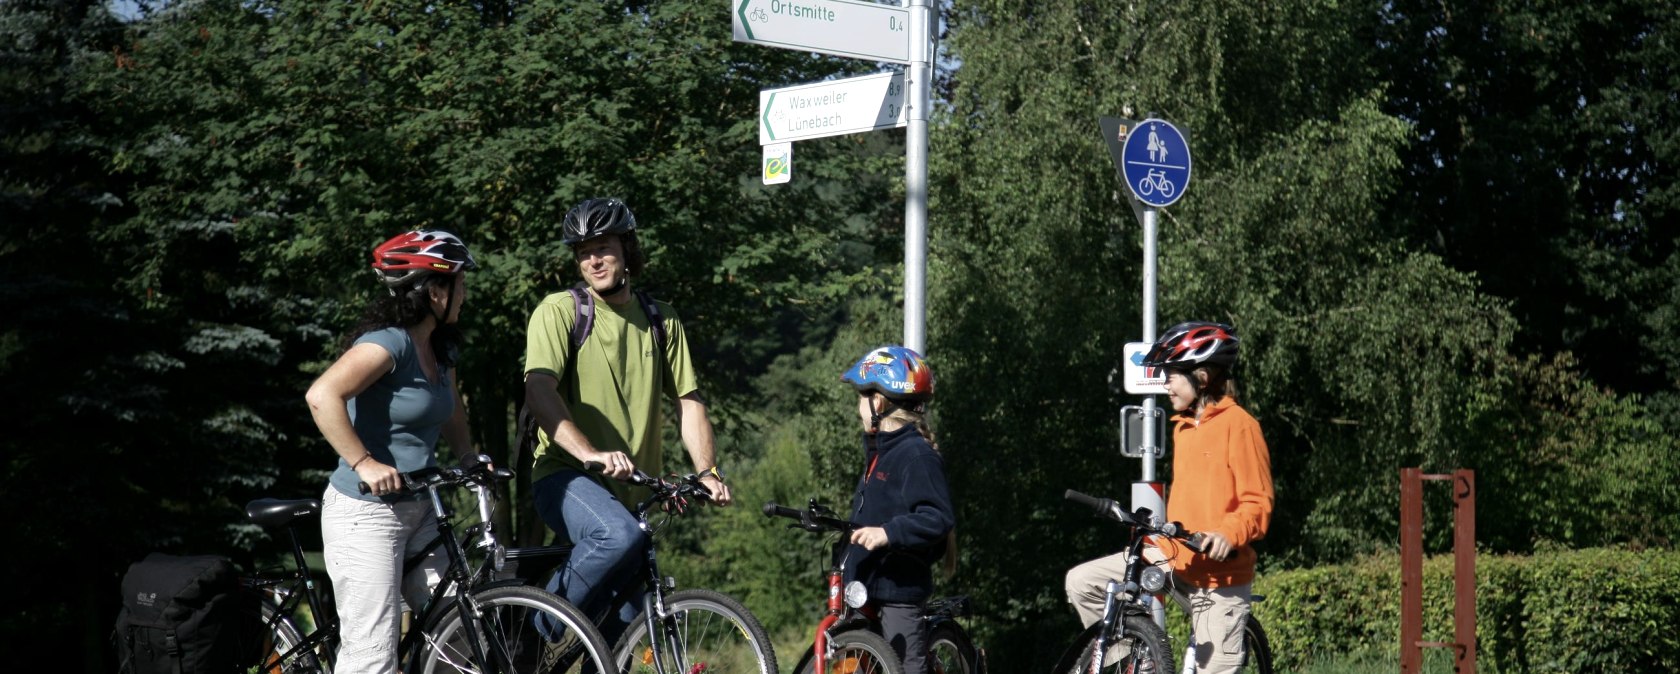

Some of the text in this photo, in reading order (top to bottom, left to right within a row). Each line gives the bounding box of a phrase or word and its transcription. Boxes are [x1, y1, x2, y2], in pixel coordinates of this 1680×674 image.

[771, 0, 835, 22] Ortsmitte
[789, 91, 848, 110] Waxweiler
[788, 112, 842, 132] Lünebach
[892, 381, 916, 391] uvex
